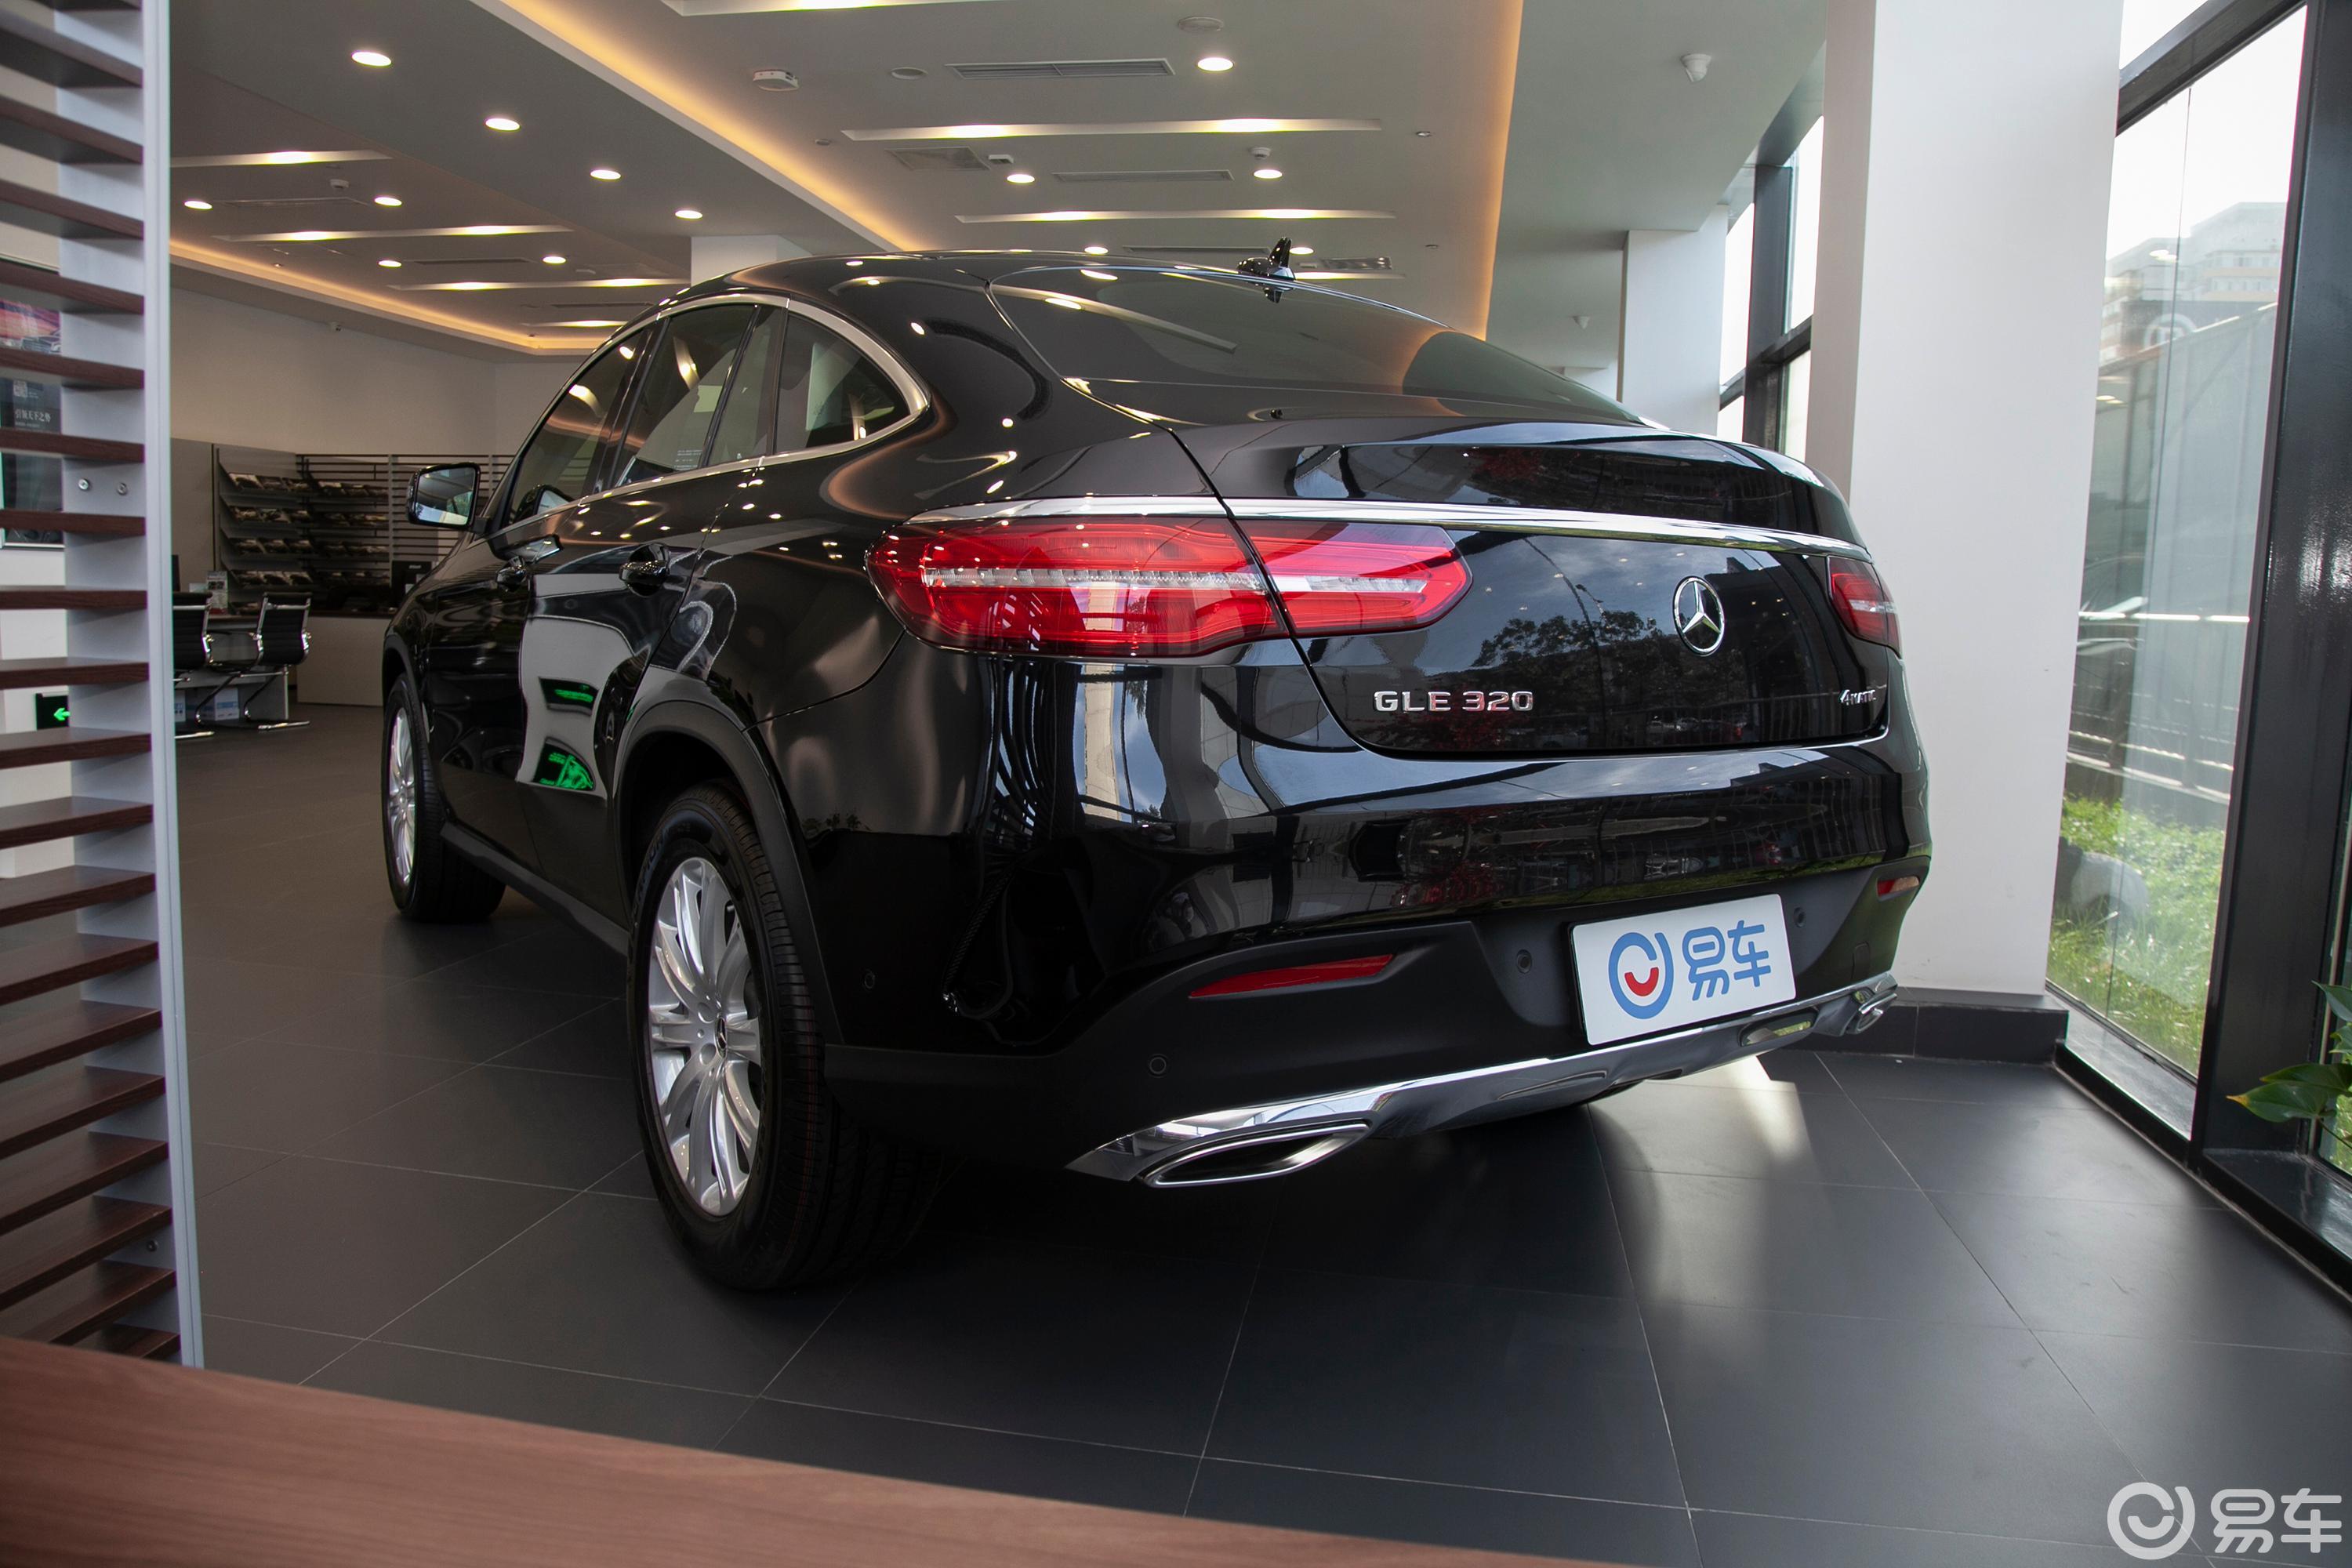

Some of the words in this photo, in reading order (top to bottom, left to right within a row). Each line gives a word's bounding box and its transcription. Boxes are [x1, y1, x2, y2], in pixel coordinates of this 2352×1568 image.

[1374, 691, 1451, 713] GLE
[1461, 691, 1534, 712] 320
[1682, 920, 1771, 1001] 易车
